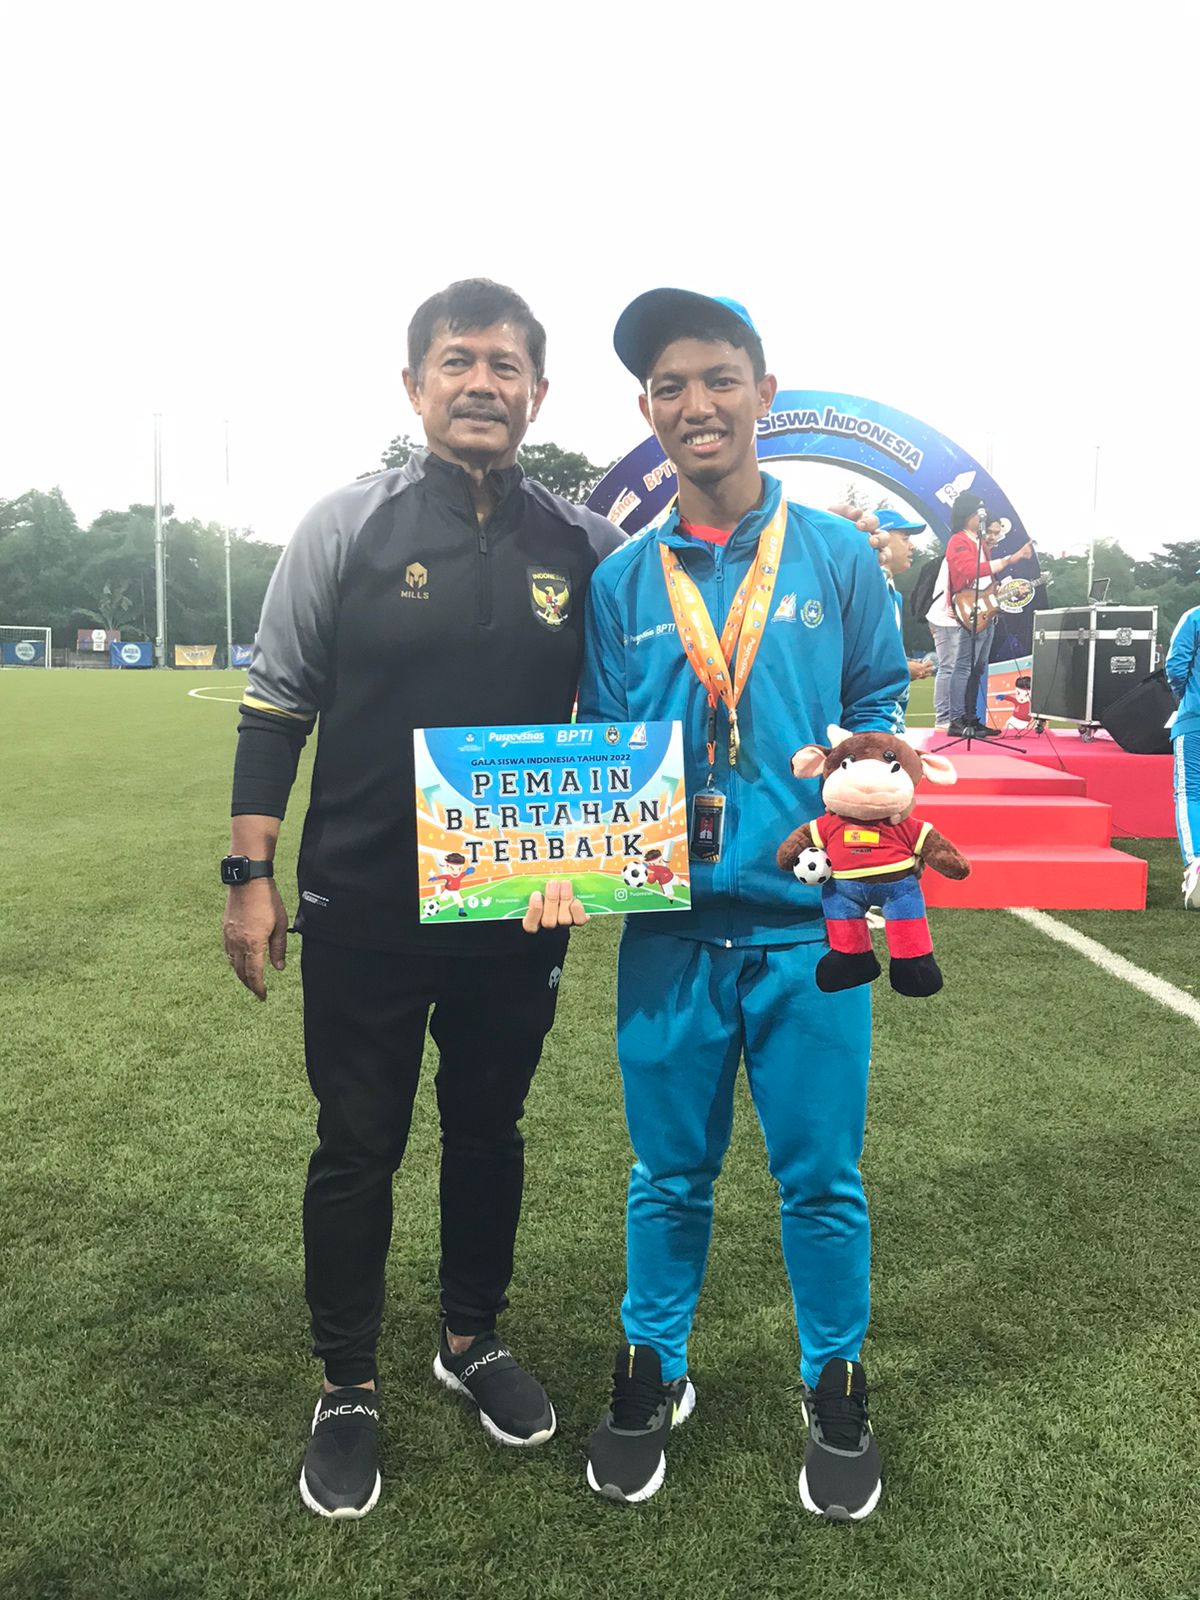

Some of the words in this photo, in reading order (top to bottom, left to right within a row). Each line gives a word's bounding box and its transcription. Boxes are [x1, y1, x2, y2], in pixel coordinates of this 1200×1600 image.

[757, 411, 820, 433] SISWA
[823, 407, 923, 469] INDONESIA
[643, 459, 677, 491] BPTI
[400, 590, 430, 600] MILLS
[655, 623, 676, 635] BPTI
[556, 728, 593, 743] BPTI
[471, 758, 496, 767] GALA
[497, 757, 525, 766] SISWA
[526, 756, 576, 764] INDONESIA
[577, 754, 608, 763] TAHUN
[610, 753, 631, 761] 2022
[473, 767, 632, 796] PEMAIN
[445, 799, 660, 831] BERTAHAN
[465, 833, 643, 864] TERBAIK
